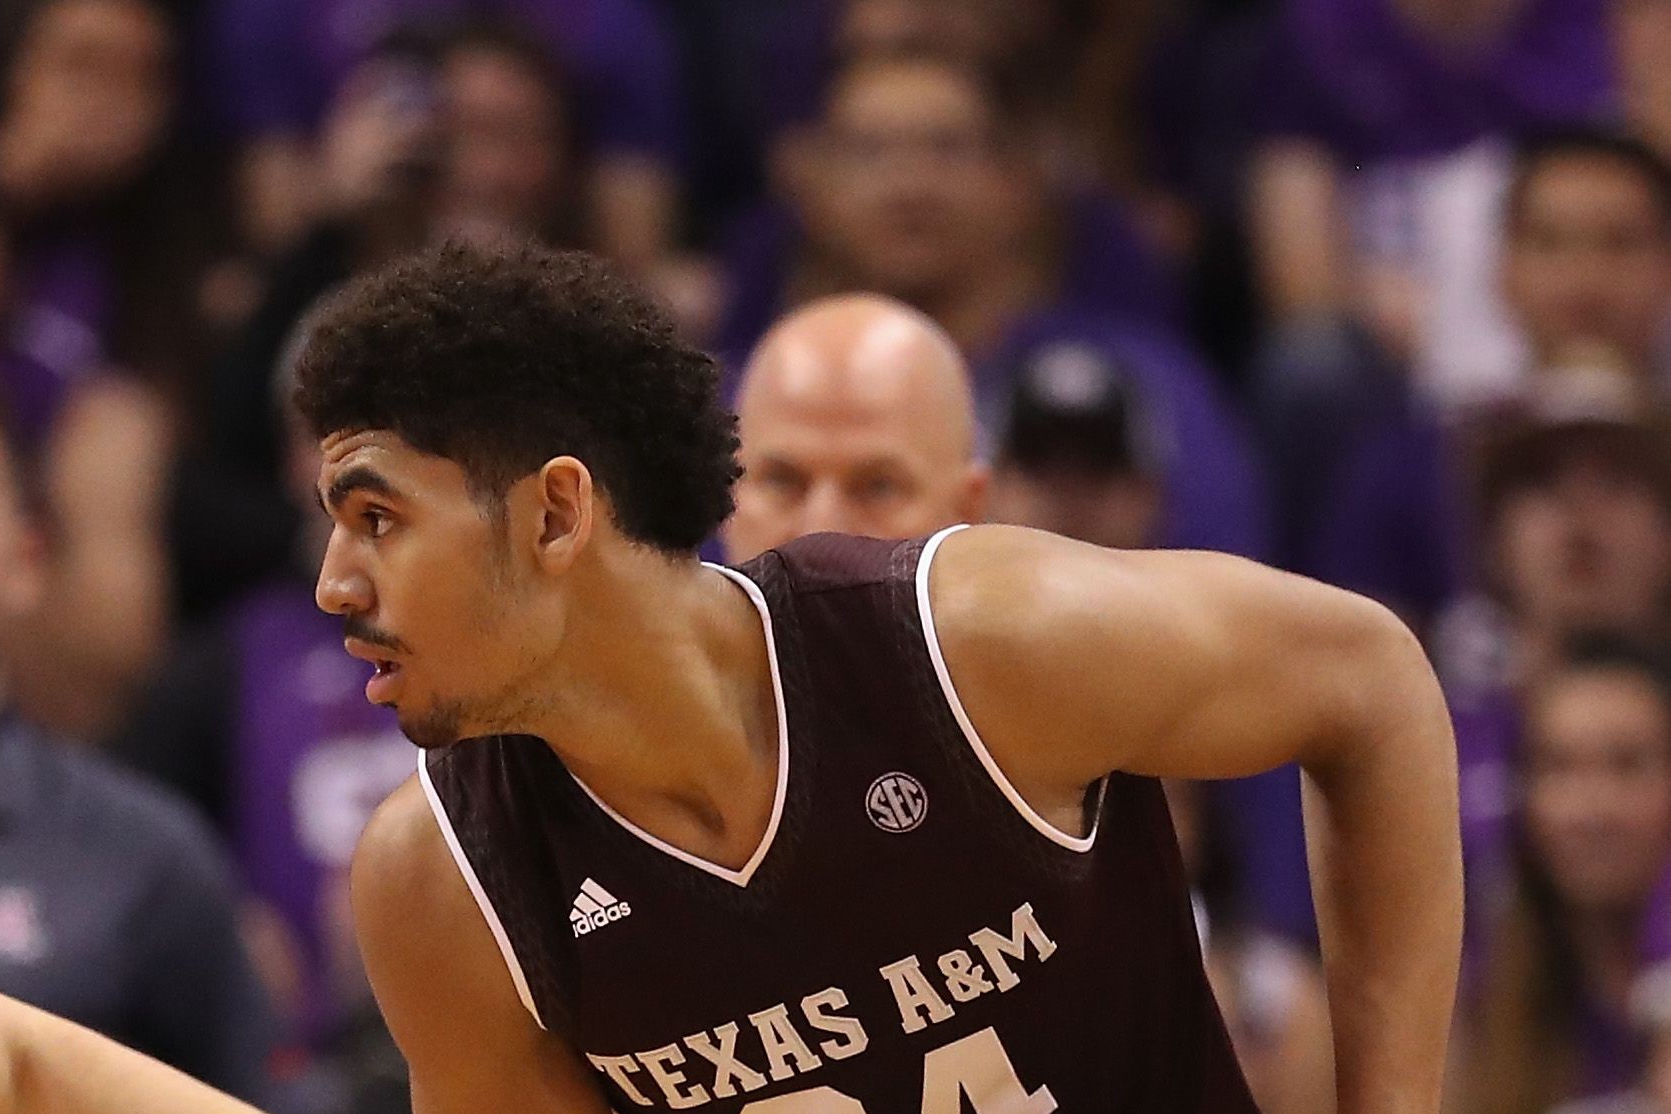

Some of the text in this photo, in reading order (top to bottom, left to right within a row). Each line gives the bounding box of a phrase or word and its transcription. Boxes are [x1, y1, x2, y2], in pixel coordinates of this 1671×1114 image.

[870, 777, 924, 830] SEC
[585, 902, 1058, 1110] TEXAS A&M
